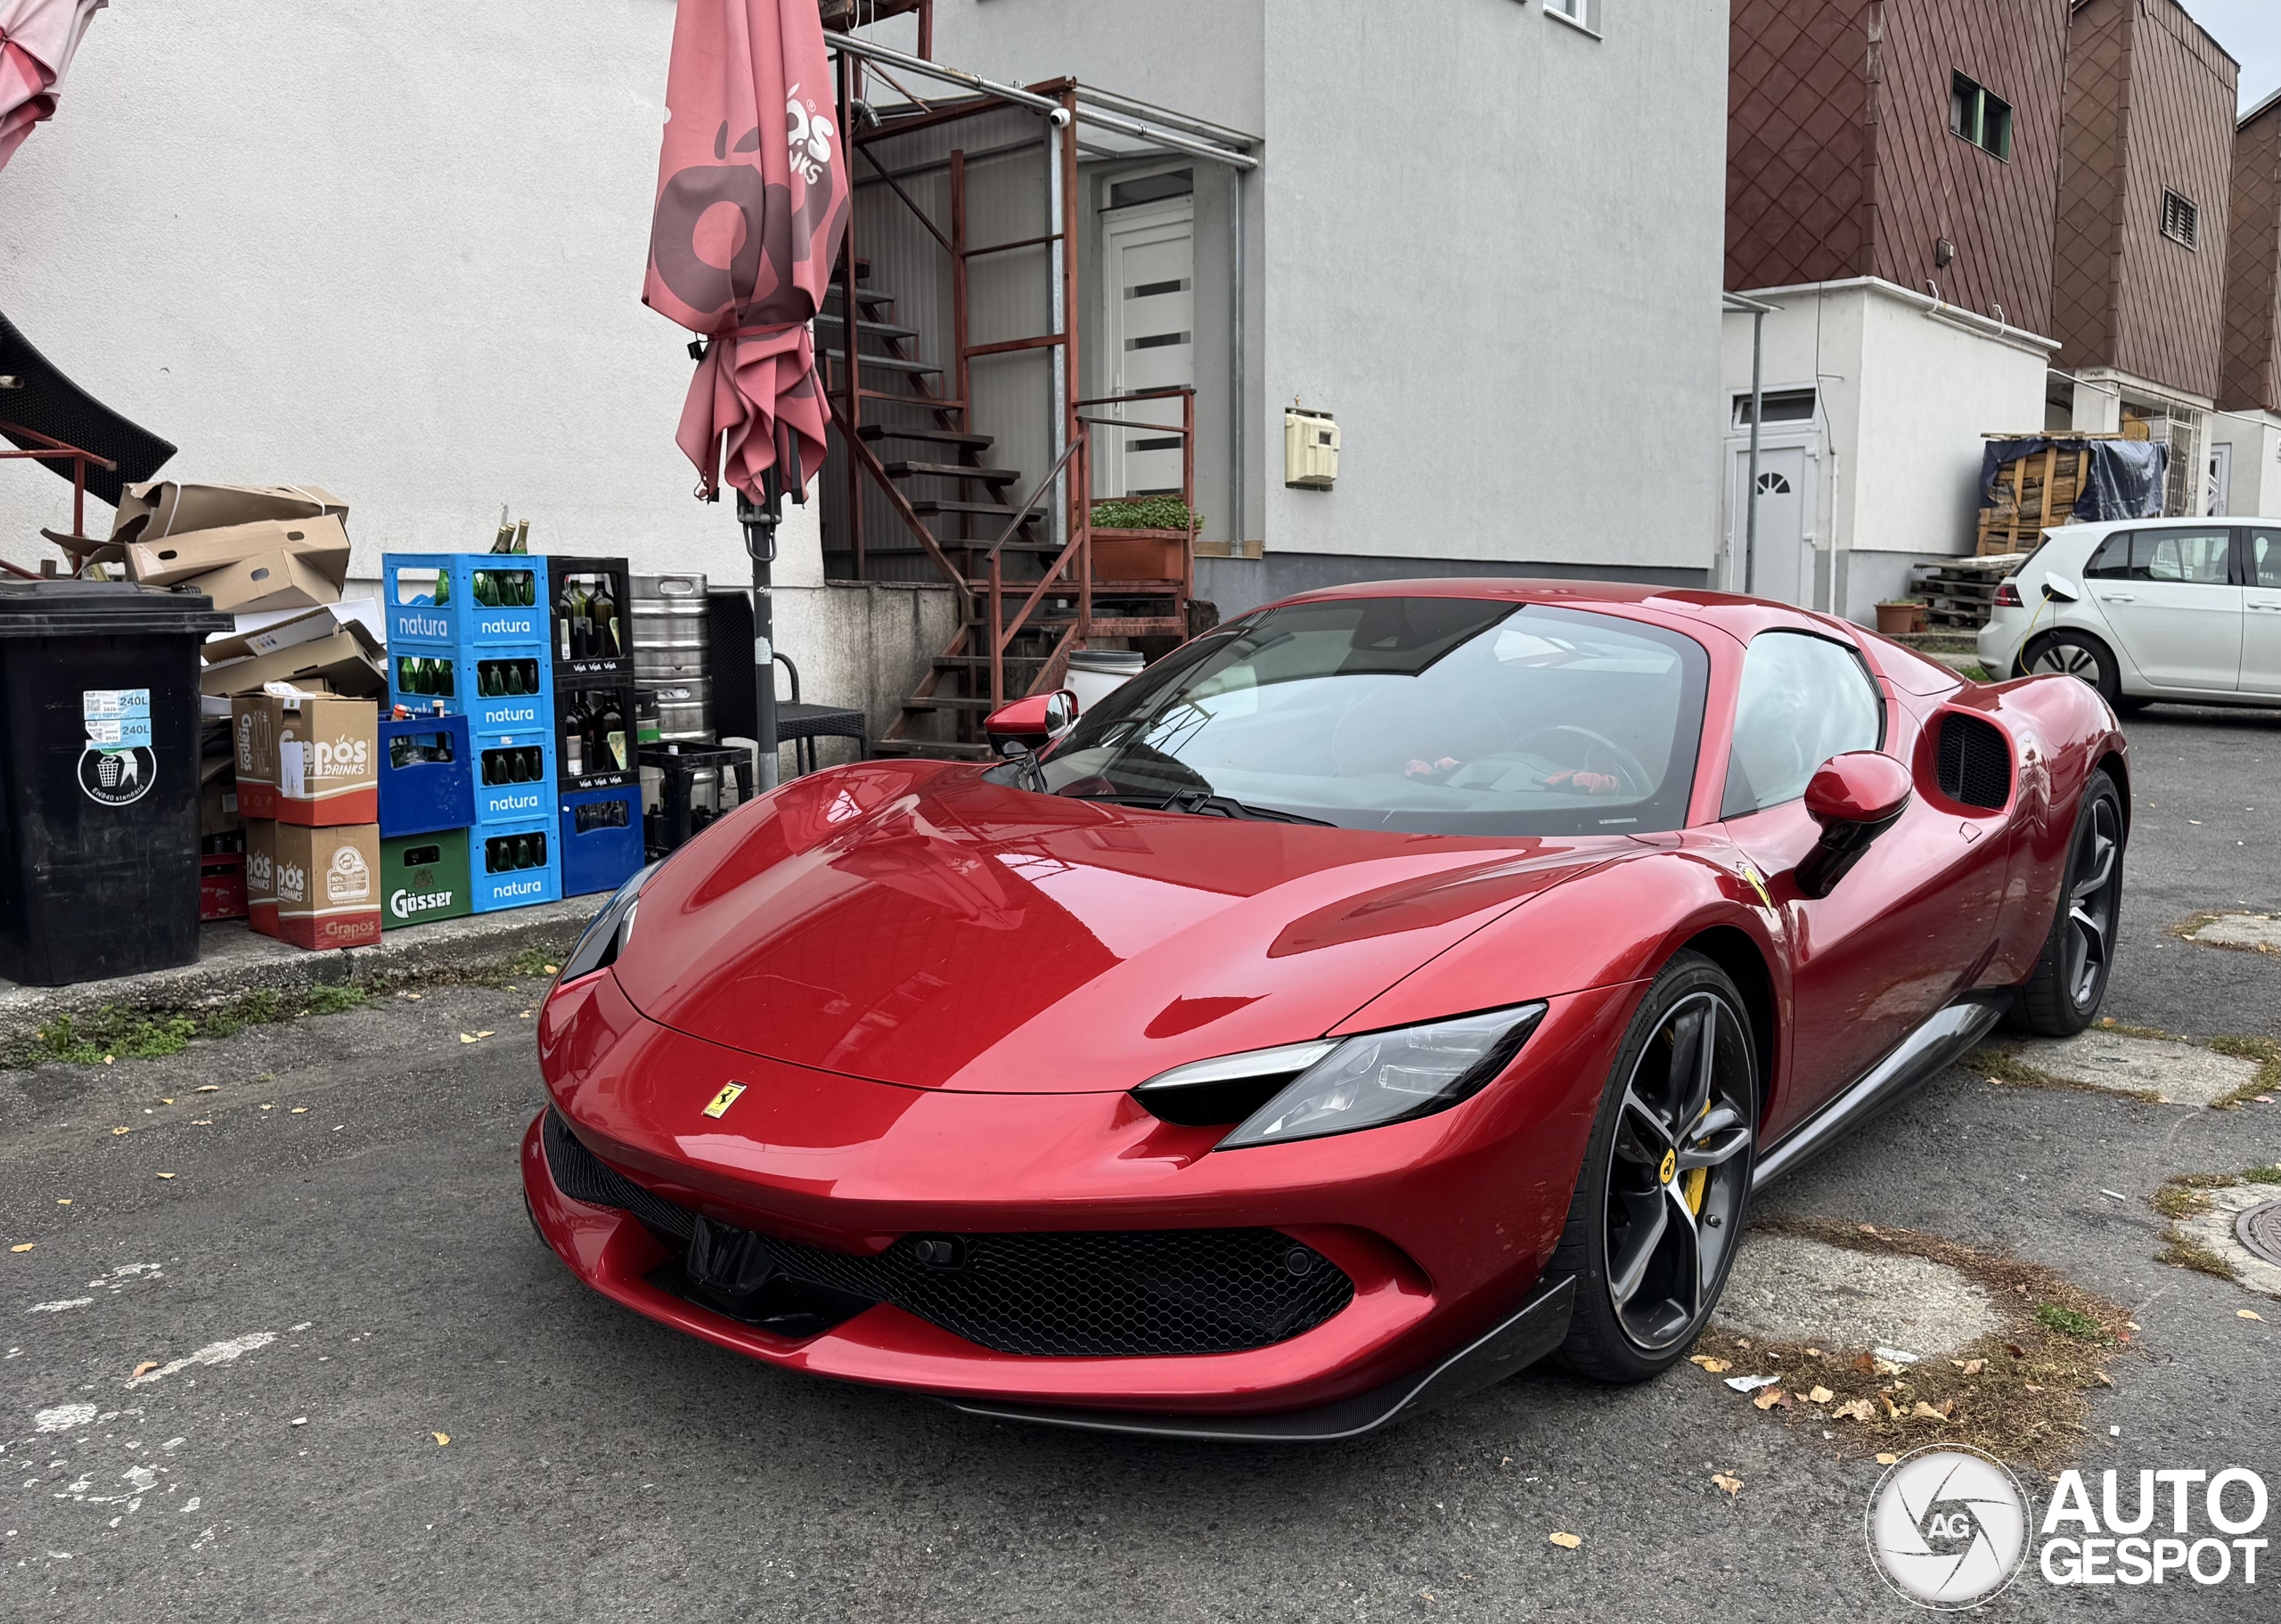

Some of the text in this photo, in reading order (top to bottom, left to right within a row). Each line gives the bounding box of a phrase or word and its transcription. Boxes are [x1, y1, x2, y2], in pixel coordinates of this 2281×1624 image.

[399, 613, 447, 637] natura
[482, 618, 530, 633] natura
[119, 697, 148, 706] 240L
[486, 707, 534, 723] natura
[122, 725, 150, 736] 240L
[323, 763, 365, 775] DRINKS
[490, 796, 538, 812] natura
[494, 881, 542, 899] natura
[390, 888, 453, 919] Gösser
